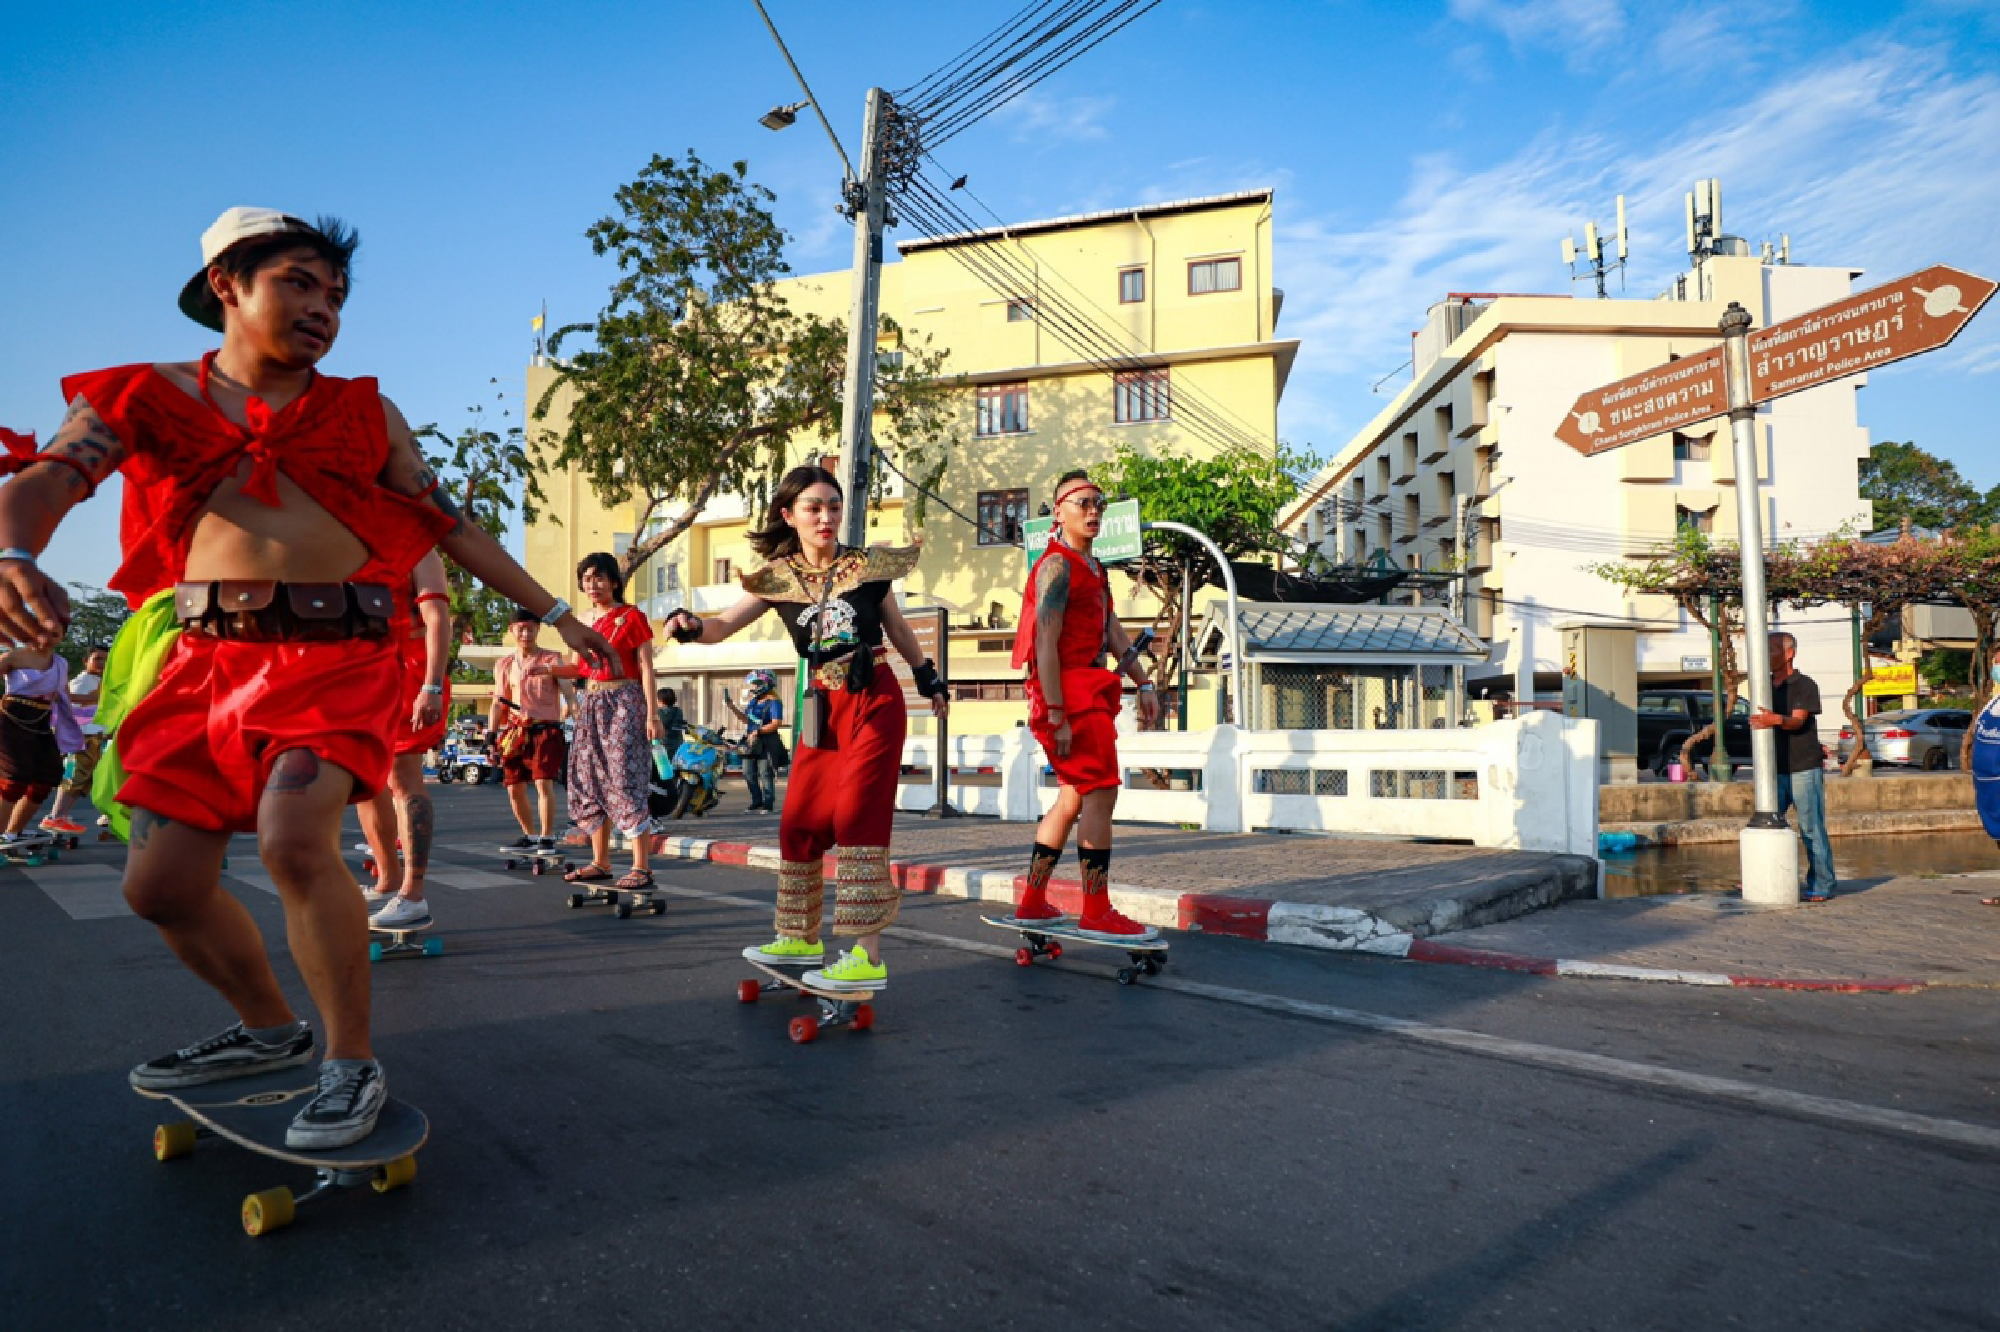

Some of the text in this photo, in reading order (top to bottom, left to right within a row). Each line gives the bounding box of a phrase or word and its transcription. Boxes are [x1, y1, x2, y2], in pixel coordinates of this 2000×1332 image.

[1757, 304, 1907, 377] สำราญราษฎร์
[1770, 347, 1892, 391] Samranrat Police Area
[1610, 379, 1713, 425] ชนะสงคราม
[1663, 412, 1689, 425] Police
[1691, 404, 1711, 416] Area
